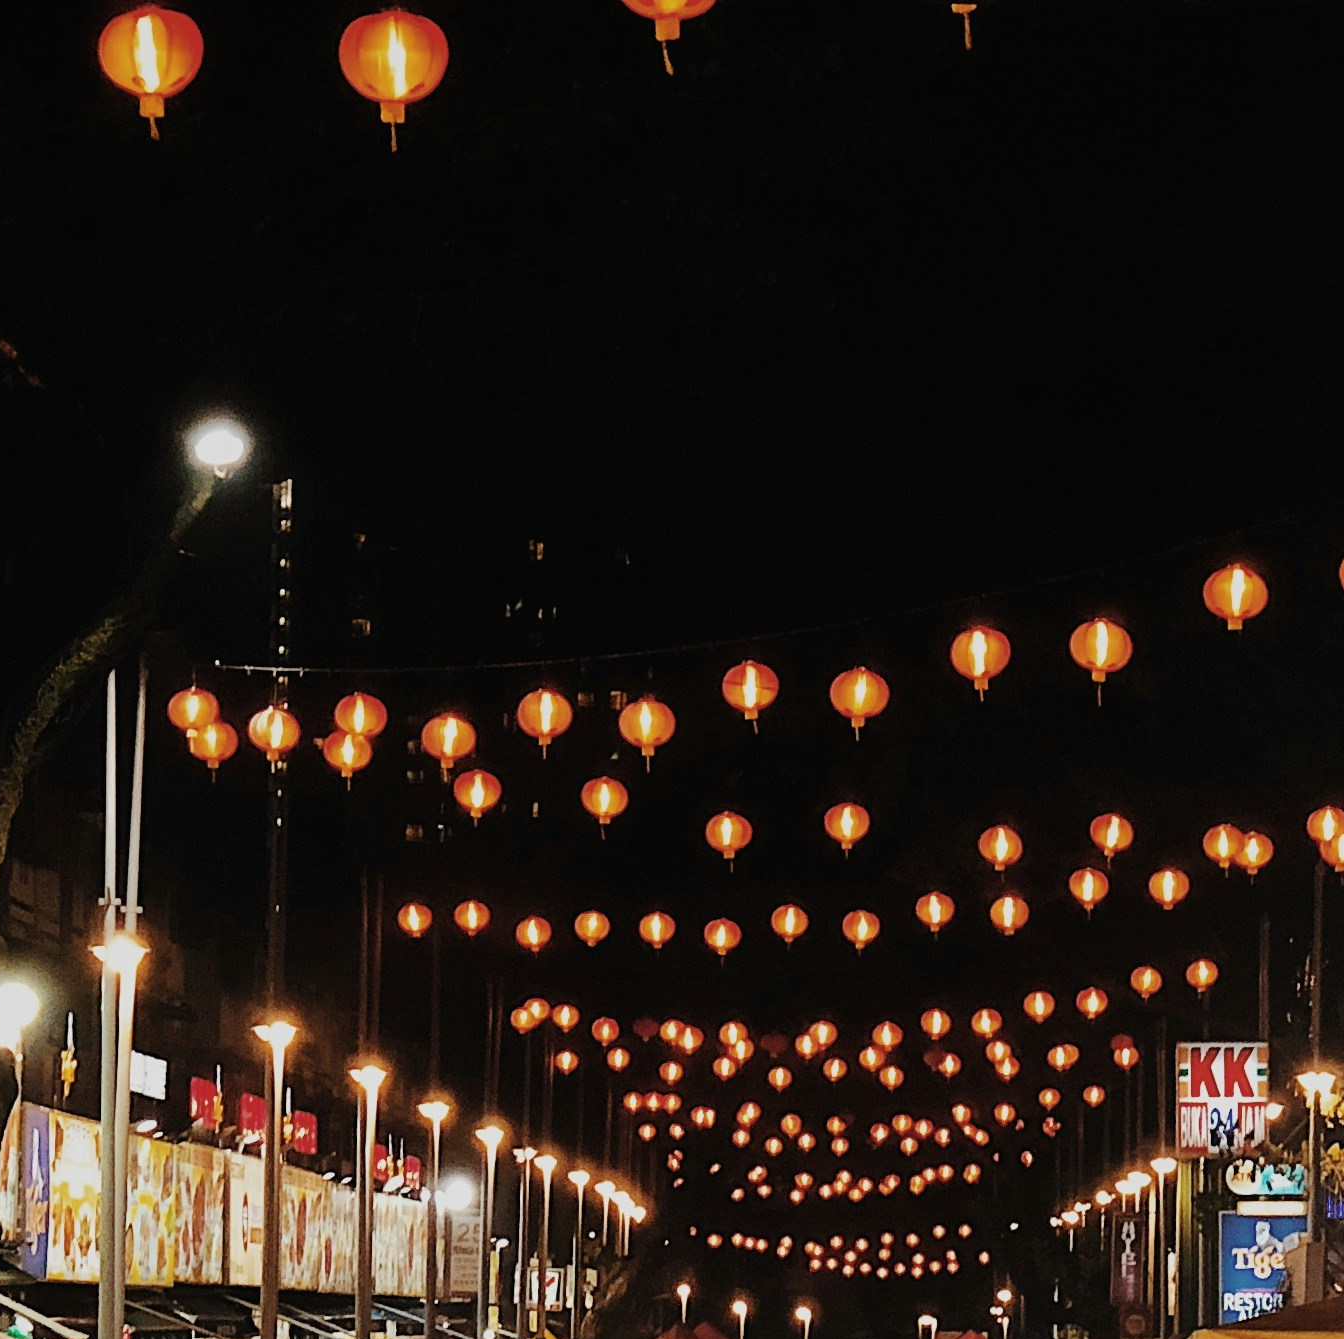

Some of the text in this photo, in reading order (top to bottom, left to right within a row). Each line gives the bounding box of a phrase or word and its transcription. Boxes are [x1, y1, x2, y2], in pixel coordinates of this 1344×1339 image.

[1190, 1046, 1256, 1098] KK
[1180, 1105, 1207, 1148] BUKA
[1231, 1245, 1286, 1280] Tige
